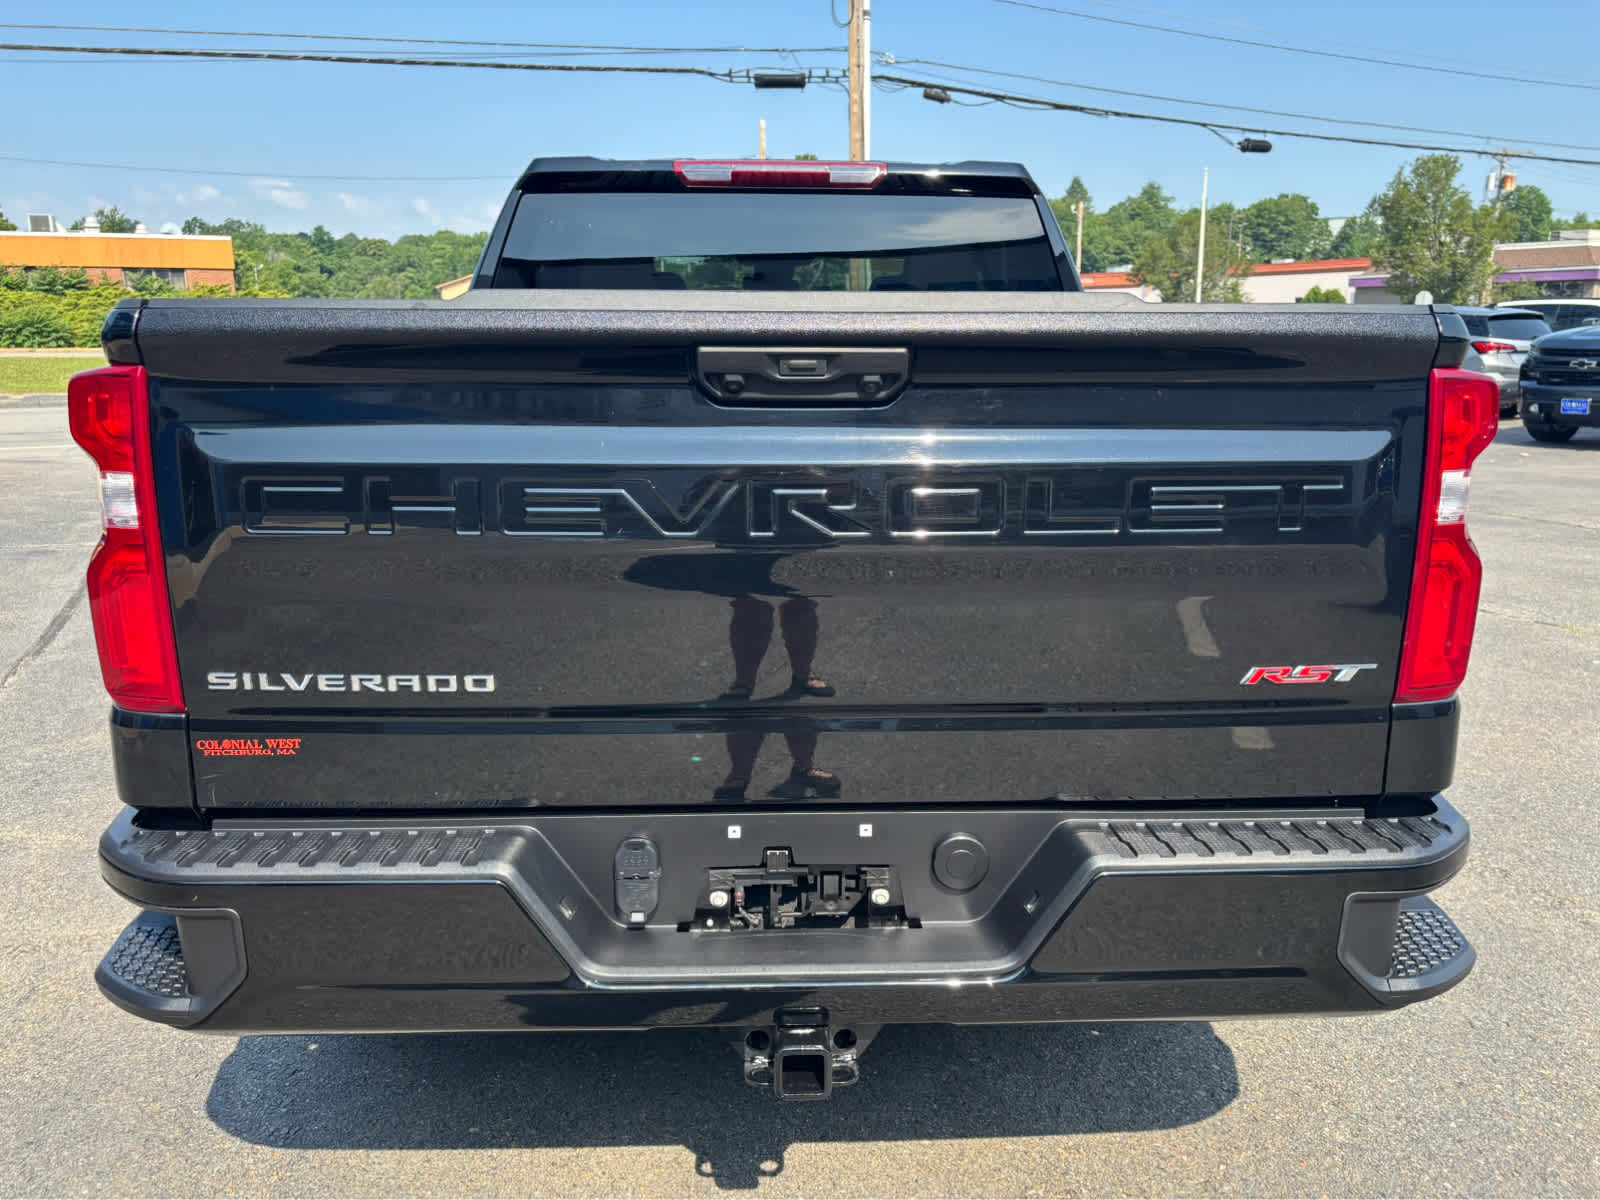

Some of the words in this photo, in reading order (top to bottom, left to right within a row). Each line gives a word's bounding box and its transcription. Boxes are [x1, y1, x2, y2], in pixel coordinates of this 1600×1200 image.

[239, 475, 1346, 537] CHEVROLET
[206, 671, 497, 693] SILVERADO
[1239, 663, 1379, 686] RST
[196, 739, 263, 751] COLONIAL
[265, 738, 301, 750] WEST
